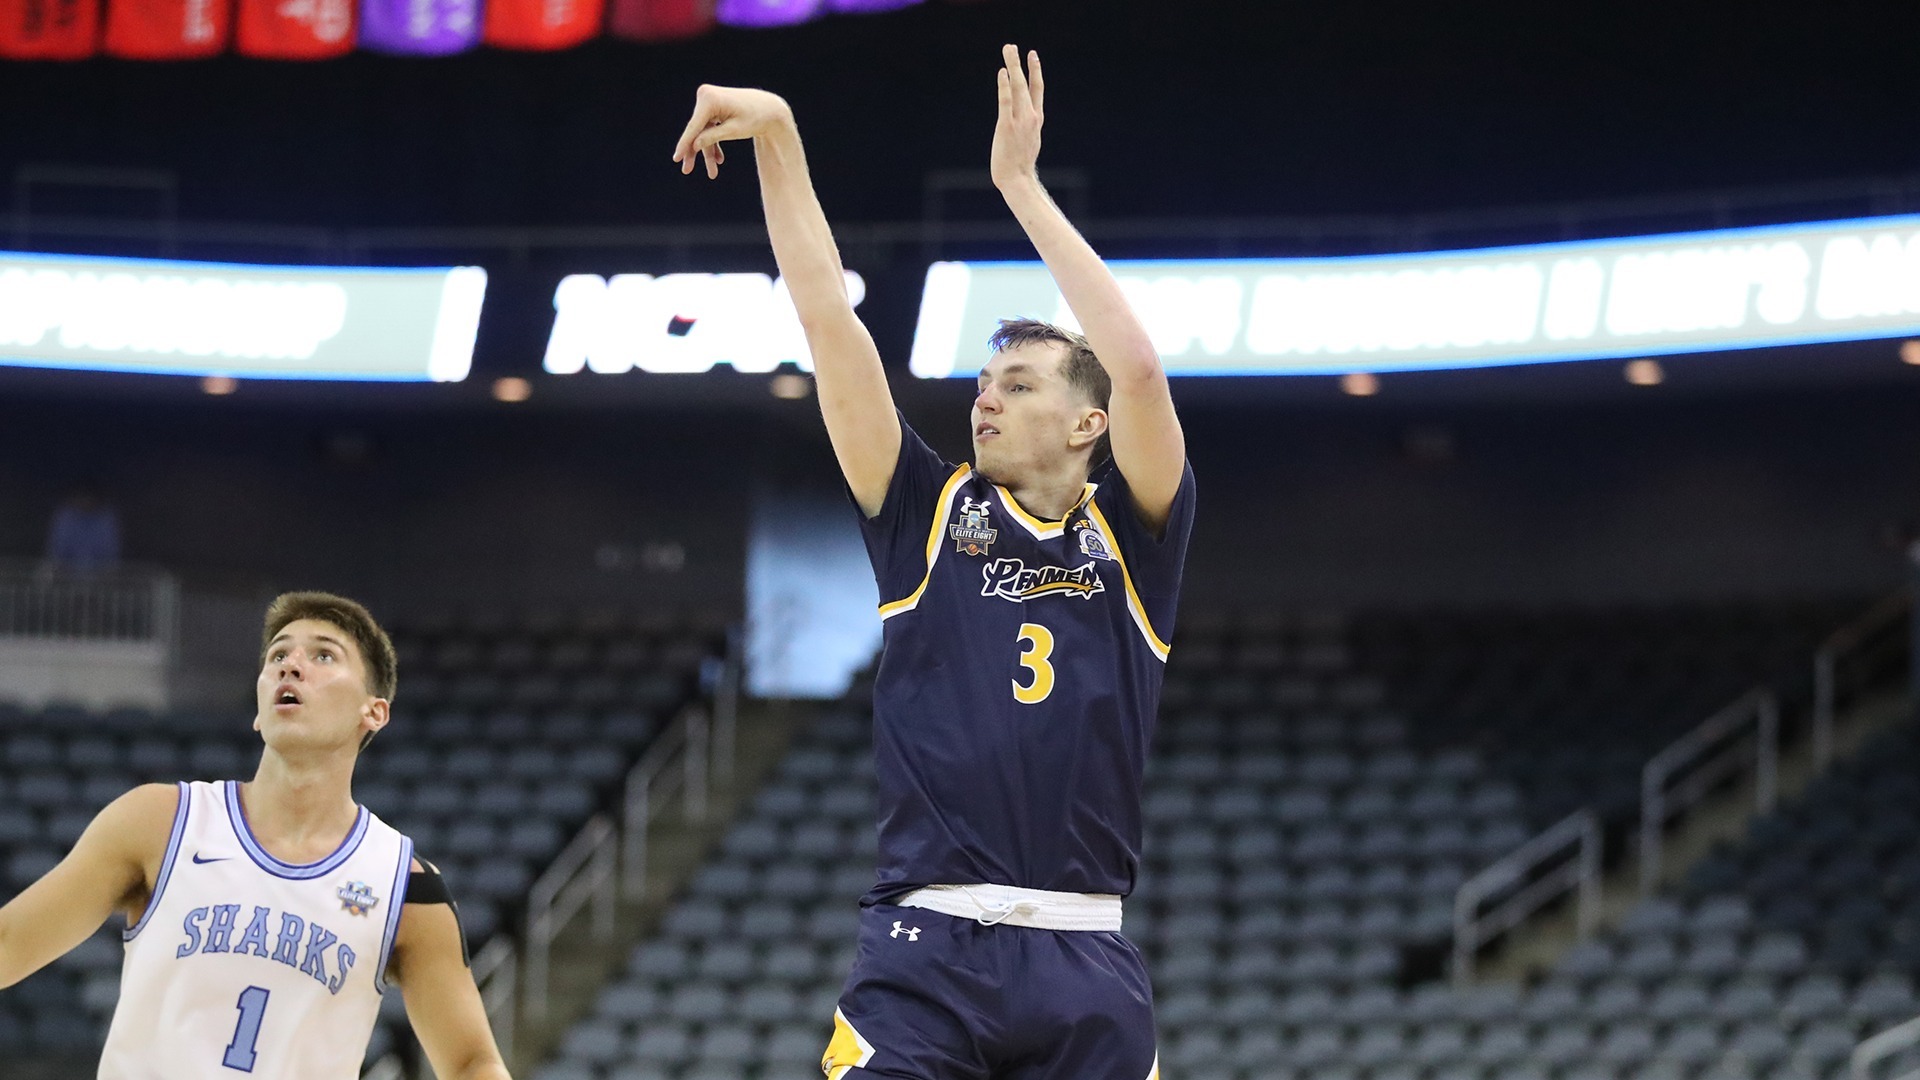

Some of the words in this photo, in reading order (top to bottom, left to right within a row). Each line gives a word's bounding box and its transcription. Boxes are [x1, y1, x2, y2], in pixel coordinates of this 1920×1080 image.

[955, 529, 973, 538] ELITE
[973, 531, 992, 540] EIGHT
[981, 558, 1105, 603] PENMEN
[1011, 622, 1055, 704] 3
[176, 903, 356, 996] SHARKS
[222, 985, 270, 1073] 1
